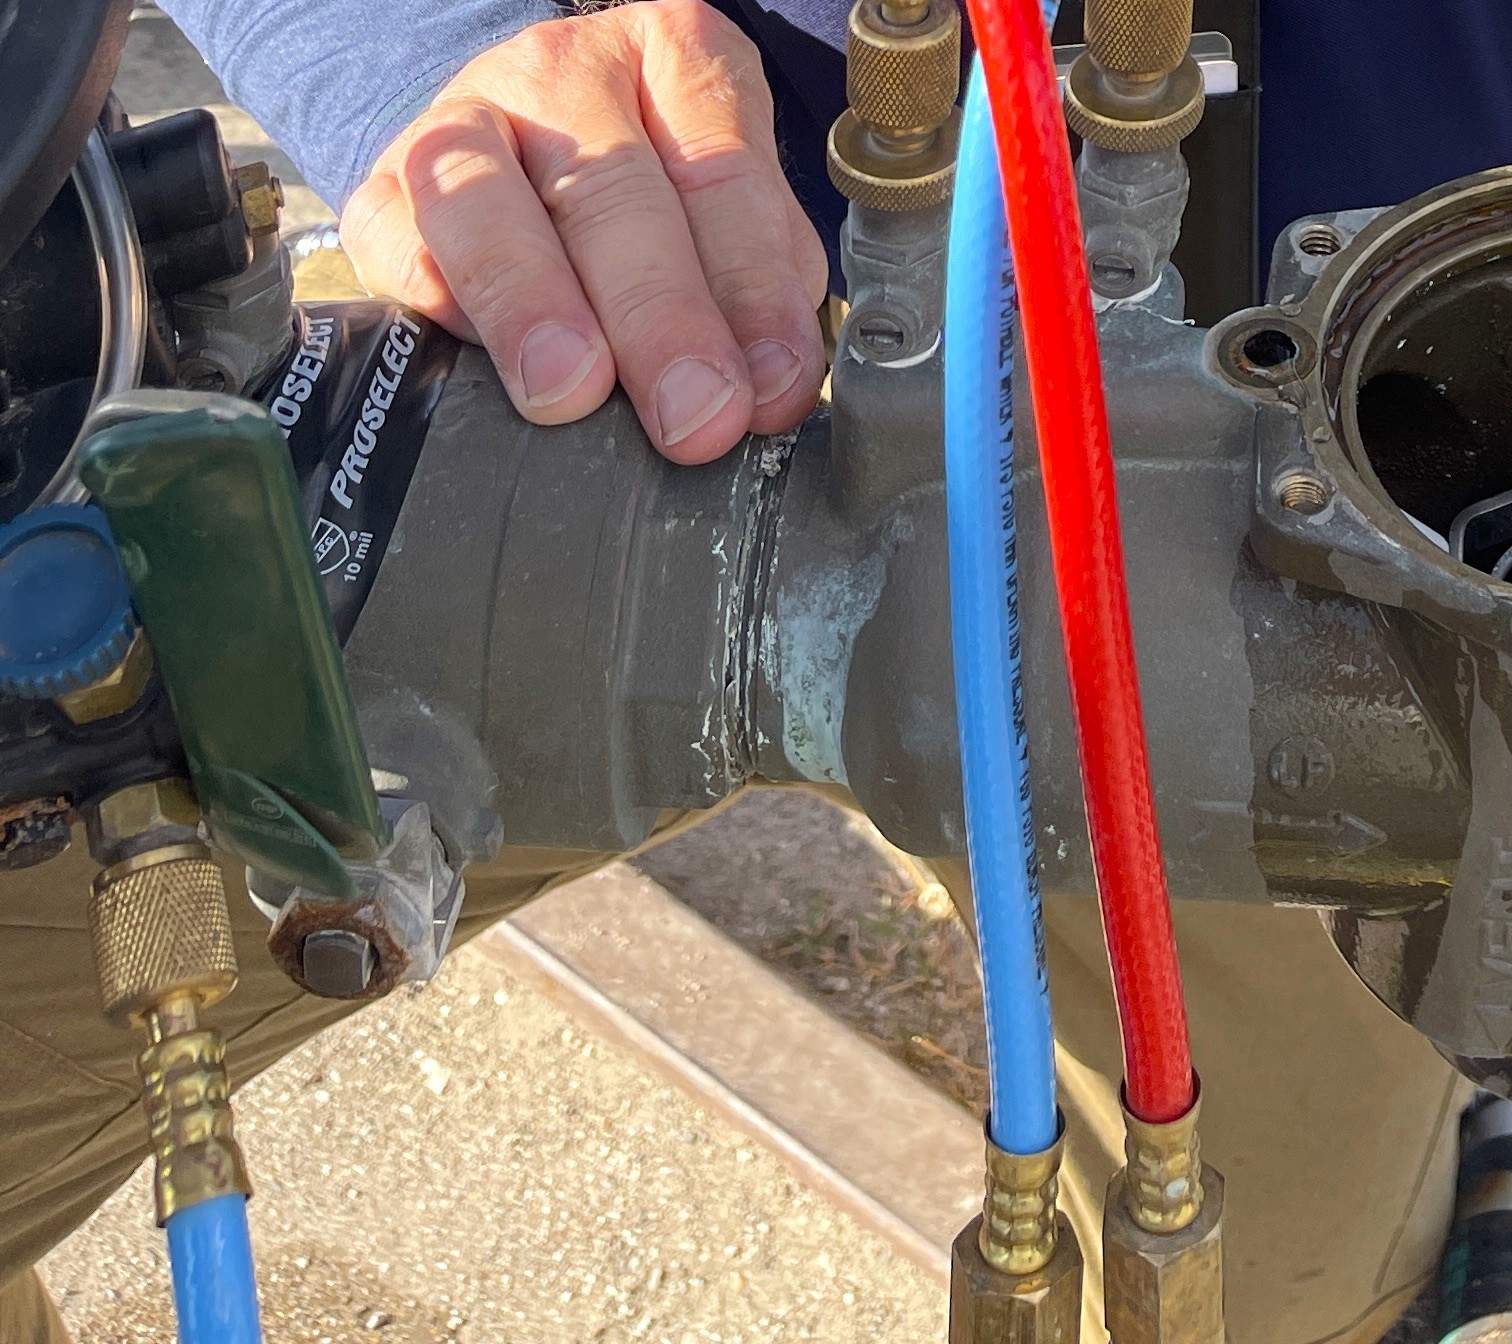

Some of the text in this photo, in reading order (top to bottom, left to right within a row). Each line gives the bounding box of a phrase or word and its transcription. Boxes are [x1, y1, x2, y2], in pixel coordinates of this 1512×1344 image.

[271, 316, 334, 440] OSELECT
[330, 309, 421, 509] PROSELECT
[344, 531, 374, 582] 10 mil
